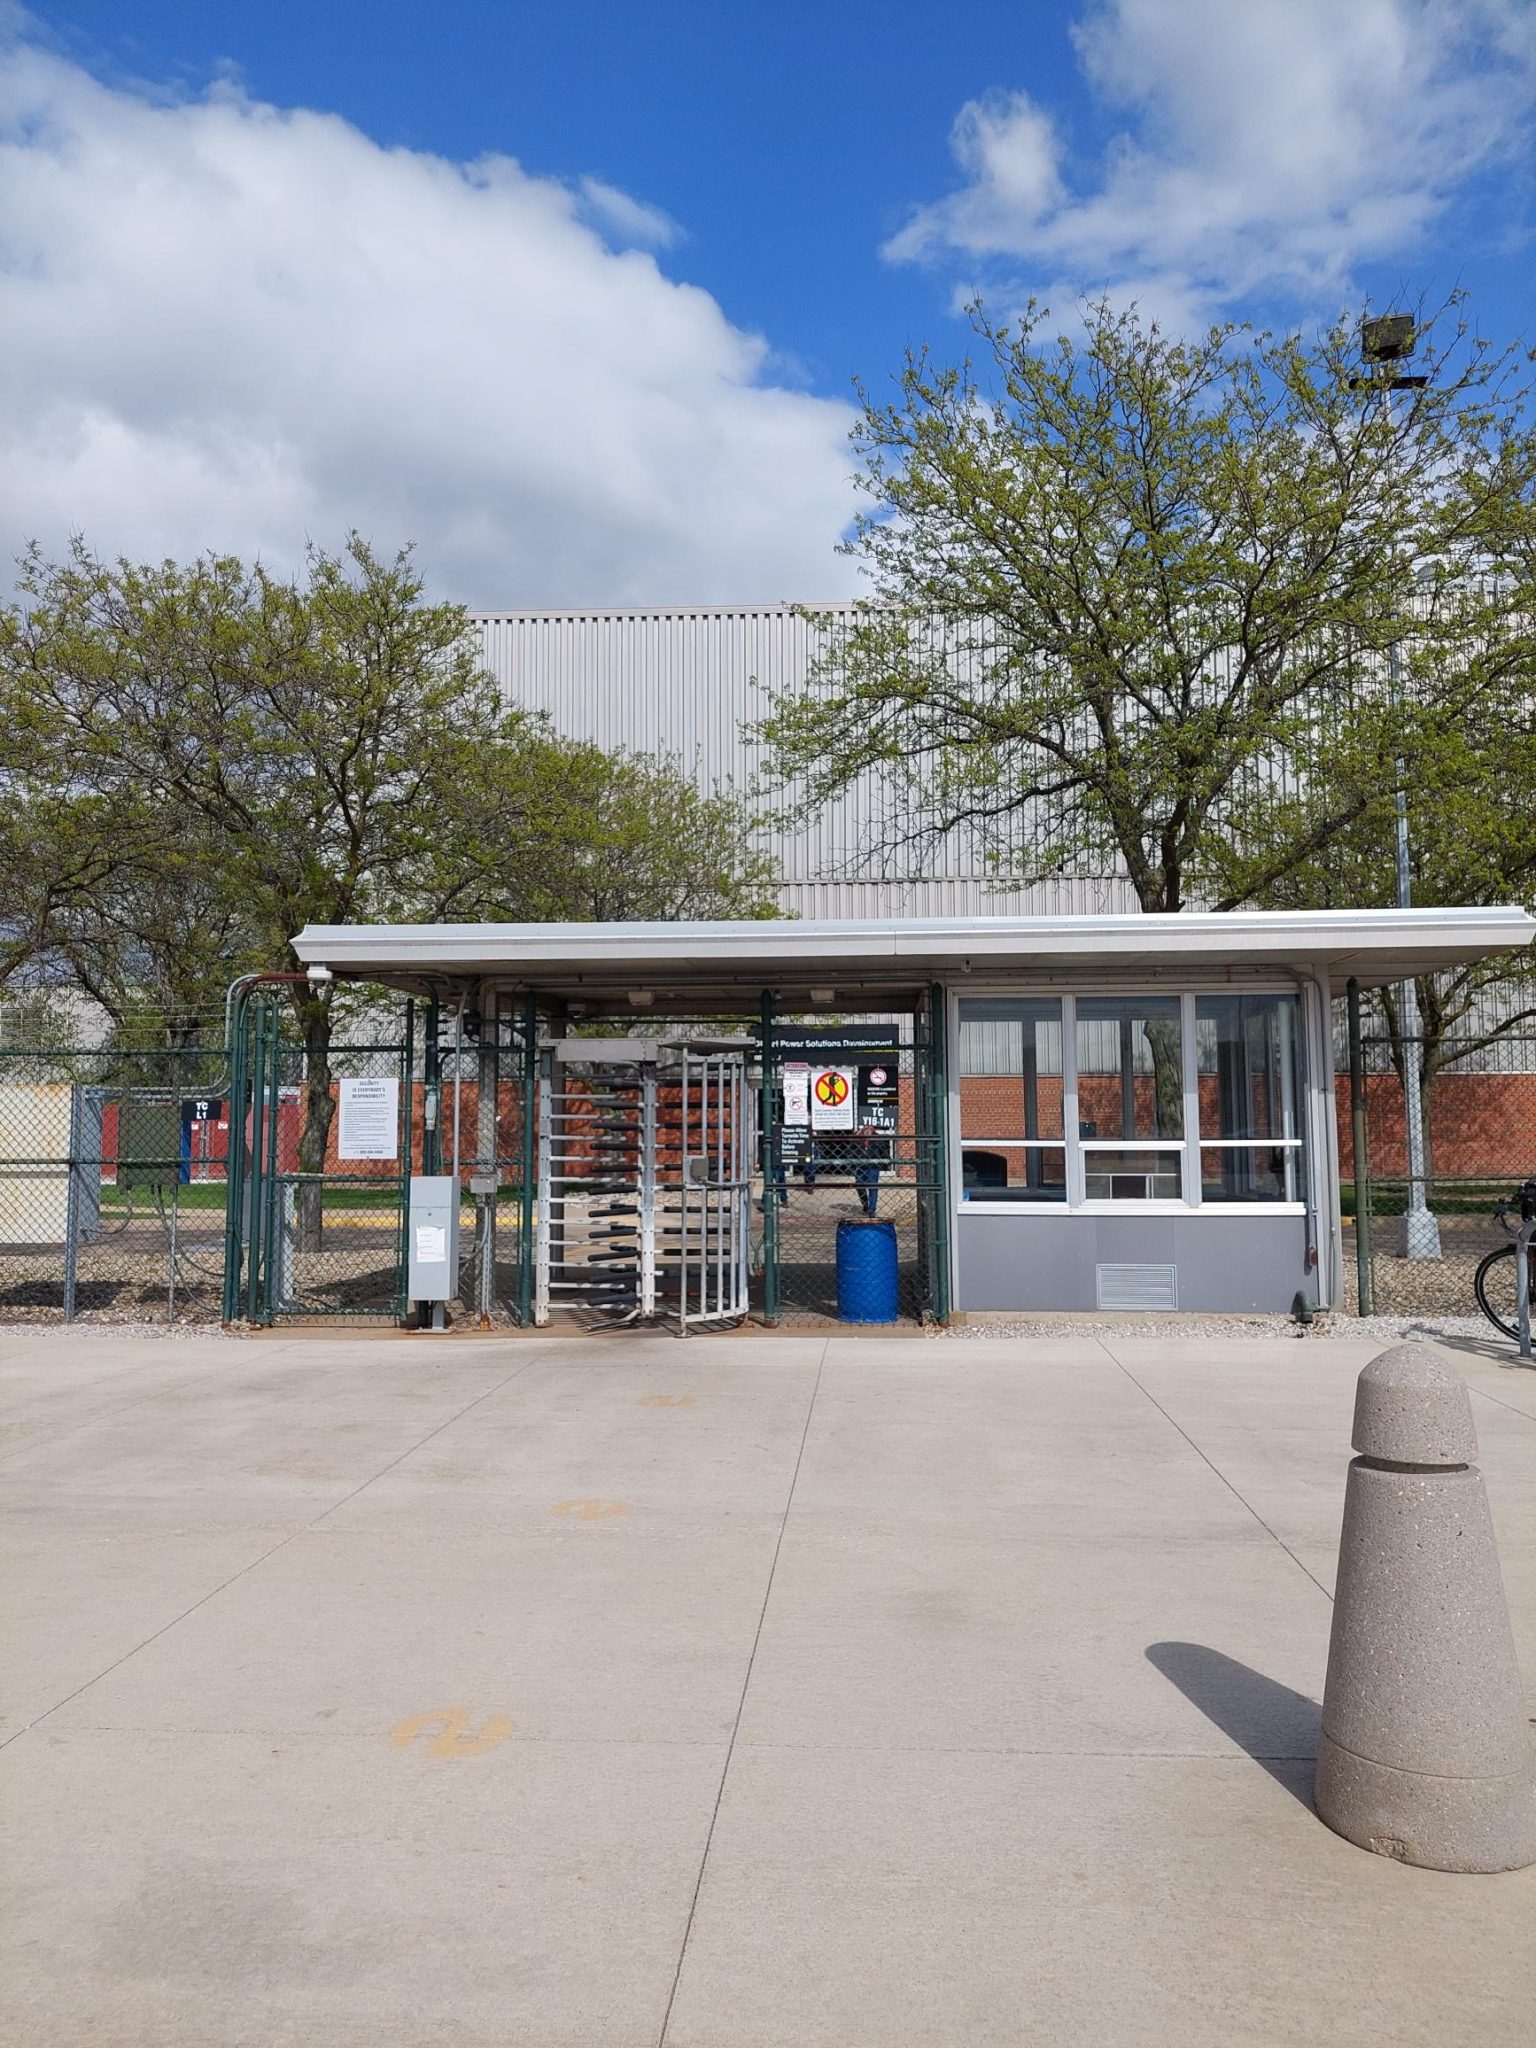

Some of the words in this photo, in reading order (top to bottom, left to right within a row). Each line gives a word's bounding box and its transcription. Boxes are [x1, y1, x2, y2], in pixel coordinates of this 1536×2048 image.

[780, 1040, 804, 1048] Power
[805, 1039, 842, 1048] Solutions
[195, 1102, 209, 1111] TC
[196, 1111, 207, 1120] L1
[871, 1107, 884, 1117] TC
